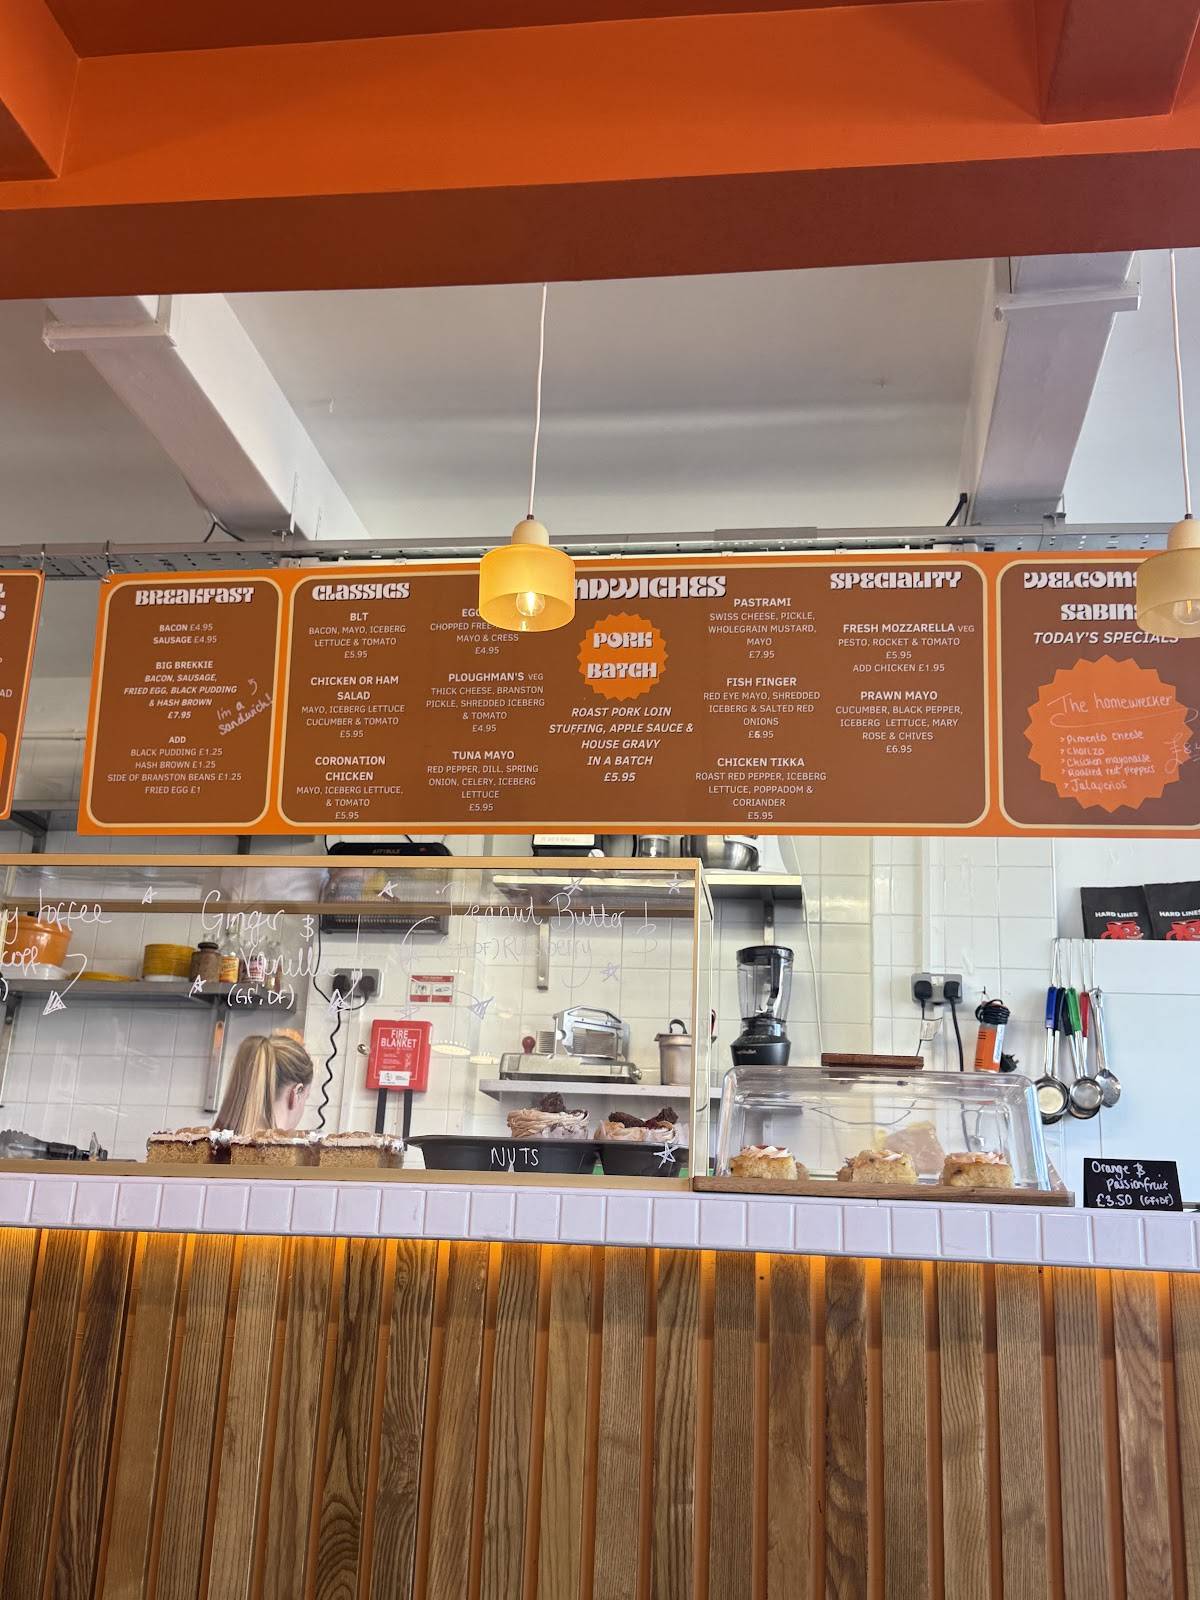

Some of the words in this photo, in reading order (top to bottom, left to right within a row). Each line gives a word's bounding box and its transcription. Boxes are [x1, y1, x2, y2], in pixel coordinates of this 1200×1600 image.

[831, 572, 961, 588] SPECIALITY
[312, 583, 409, 600] CLASSICS
[575, 577, 725, 599] NDWICHES
[136, 588, 254, 605] BREAKFAST
[734, 598, 790, 608] PASTRAMI
[350, 613, 368, 622] BLT
[710, 613, 738, 621] SWISS
[741, 612, 778, 621] CHEESE,
[781, 612, 814, 620] PICKLE,
[160, 624, 188, 632] BACON
[190, 624, 213, 632] £4.95
[309, 627, 339, 635] BACON,
[342, 626, 367, 634] MAYO,
[370, 625, 405, 634] ICEBERG
[431, 623, 469, 631] CHOPPED
[709, 625, 767, 634] WHOLEGRAIN
[771, 625, 816, 633] MUSTARD,
[844, 624, 878, 633] FRESH
[882, 624, 954, 633] MOZZARELLA
[154, 636, 192, 645] SAUSAGE
[194, 636, 217, 644] £4.95
[457, 635, 480, 643] MAYO
[492, 634, 518, 642] CRESS
[594, 632, 652, 647] PORK
[747, 638, 771, 646] MAYO
[1034, 632, 1098, 643] TODAY'S
[315, 639, 351, 647] LETTUCE
[362, 638, 396, 646] TOMATO
[839, 639, 870, 647] PESTO,
[873, 638, 908, 647] ROCKET
[922, 638, 960, 646] TOMATO
[345, 651, 367, 659] £5.95
[476, 647, 499, 655] £4.95
[749, 651, 774, 659] £7.95
[886, 651, 911, 660] £5.95
[156, 662, 172, 670] BIG
[175, 661, 213, 670] BREKKIE
[588, 663, 656, 678] BATCH
[145, 675, 174, 683] BACON,
[177, 674, 216, 682] SAUSAGE,
[311, 677, 356, 686] CHICKEN
[359, 676, 373, 685] OR
[376, 676, 398, 685] HAM
[449, 672, 524, 682] PLOUGHMAN'S
[727, 678, 752, 687] FISH
[756, 677, 796, 687] FINGER
[150, 687, 168, 695] EGG,
[171, 687, 197, 695] BLACK
[199, 686, 237, 694] PUDDING
[431, 688, 456, 696] THICK
[460, 687, 494, 695] CHEESE,
[497, 686, 543, 695] BRANSTON
[337, 692, 370, 701] SALAD
[742, 692, 769, 700] MAYO,
[773, 692, 820, 700] SHREDDED
[861, 691, 901, 701] PRAWN
[905, 691, 937, 701] MAYO
[157, 699, 180, 707] HASH
[182, 699, 212, 707] BROWN
[426, 700, 458, 708] PICKLE,
[461, 700, 505, 708] SHREDDED
[508, 699, 544, 707] ICEBERG
[1047, 692, 1089, 713] The
[302, 706, 327, 714] MAYO,
[330, 706, 365, 714] ICEBERG
[368, 705, 405, 713] LETTUCE
[572, 708, 609, 717] ROAST
[611, 707, 641, 717] PORK
[644, 707, 671, 717] LOIN
[710, 705, 747, 713] ICEBERG
[760, 705, 794, 713] SALTED
[797, 705, 814, 713] RED
[836, 706, 889, 714] CUCUMBER,
[893, 706, 922, 714] BLACK
[926, 706, 962, 714] PEPPER,
[168, 711, 191, 719] £7.95
[472, 712, 507, 720] TOMATO
[307, 718, 353, 726] CUCUMBER
[364, 717, 398, 726] TOMATO
[744, 718, 778, 726] ONIONS
[841, 719, 880, 727] ICEBERG
[886, 719, 929, 727] LETTUCE,
[933, 719, 958, 727] MARY
[473, 725, 496, 733] £4.95
[549, 724, 605, 734] STUFFING,
[609, 724, 644, 733] APPLE
[646, 724, 683, 733] SAUCE
[340, 730, 363, 738] £5.95
[863, 732, 886, 740] ROSE
[899, 732, 933, 741] CHIVES
[169, 736, 186, 744] ADD
[582, 740, 619, 749] HOUSE
[623, 740, 660, 749] GRAVY
[887, 745, 912, 754] £6.95
[452, 751, 481, 760] TUNA
[485, 751, 514, 760] MAYO
[315, 756, 385, 766] CORONATION
[615, 756, 653, 766] BATCH
[718, 758, 767, 767] CHICKEN
[770, 758, 804, 767] TIKKA
[428, 766, 443, 774] RED
[446, 766, 480, 774] PEPPER,
[483, 765, 503, 773] DILL,
[507, 765, 538, 773] SPRING
[326, 772, 373, 781] CHICKEN
[604, 773, 636, 782] £5.95
[696, 773, 725, 781] ROAST
[728, 773, 745, 781] RED
[748, 773, 784, 781] PEPPER,
[787, 772, 826, 781] ICEBERG
[429, 778, 459, 786] ONION,
[462, 778, 495, 786] CELERY,
[499, 778, 535, 786] ICEBERG
[297, 787, 322, 795] MAYO,
[325, 786, 361, 795] ICEBERG
[364, 786, 403, 794] LETTUCE,
[709, 786, 750, 794] LETTUCE,
[754, 786, 803, 794] POPPADOM
[462, 791, 499, 799] LETTUCE
[335, 799, 369, 807] TOMATO
[733, 799, 785, 807] CORIANDER
[470, 804, 493, 812] £5.95
[336, 812, 359, 820] £5.95
[748, 812, 773, 820] £5.95
[391, 1029, 409, 1040] FIRE
[380, 1037, 417, 1049] BLANKET
[490, 1146, 540, 1168] NUTS
[1091, 1160, 1131, 1180] Orange
[1095, 1193, 1133, 1207] £3.50
